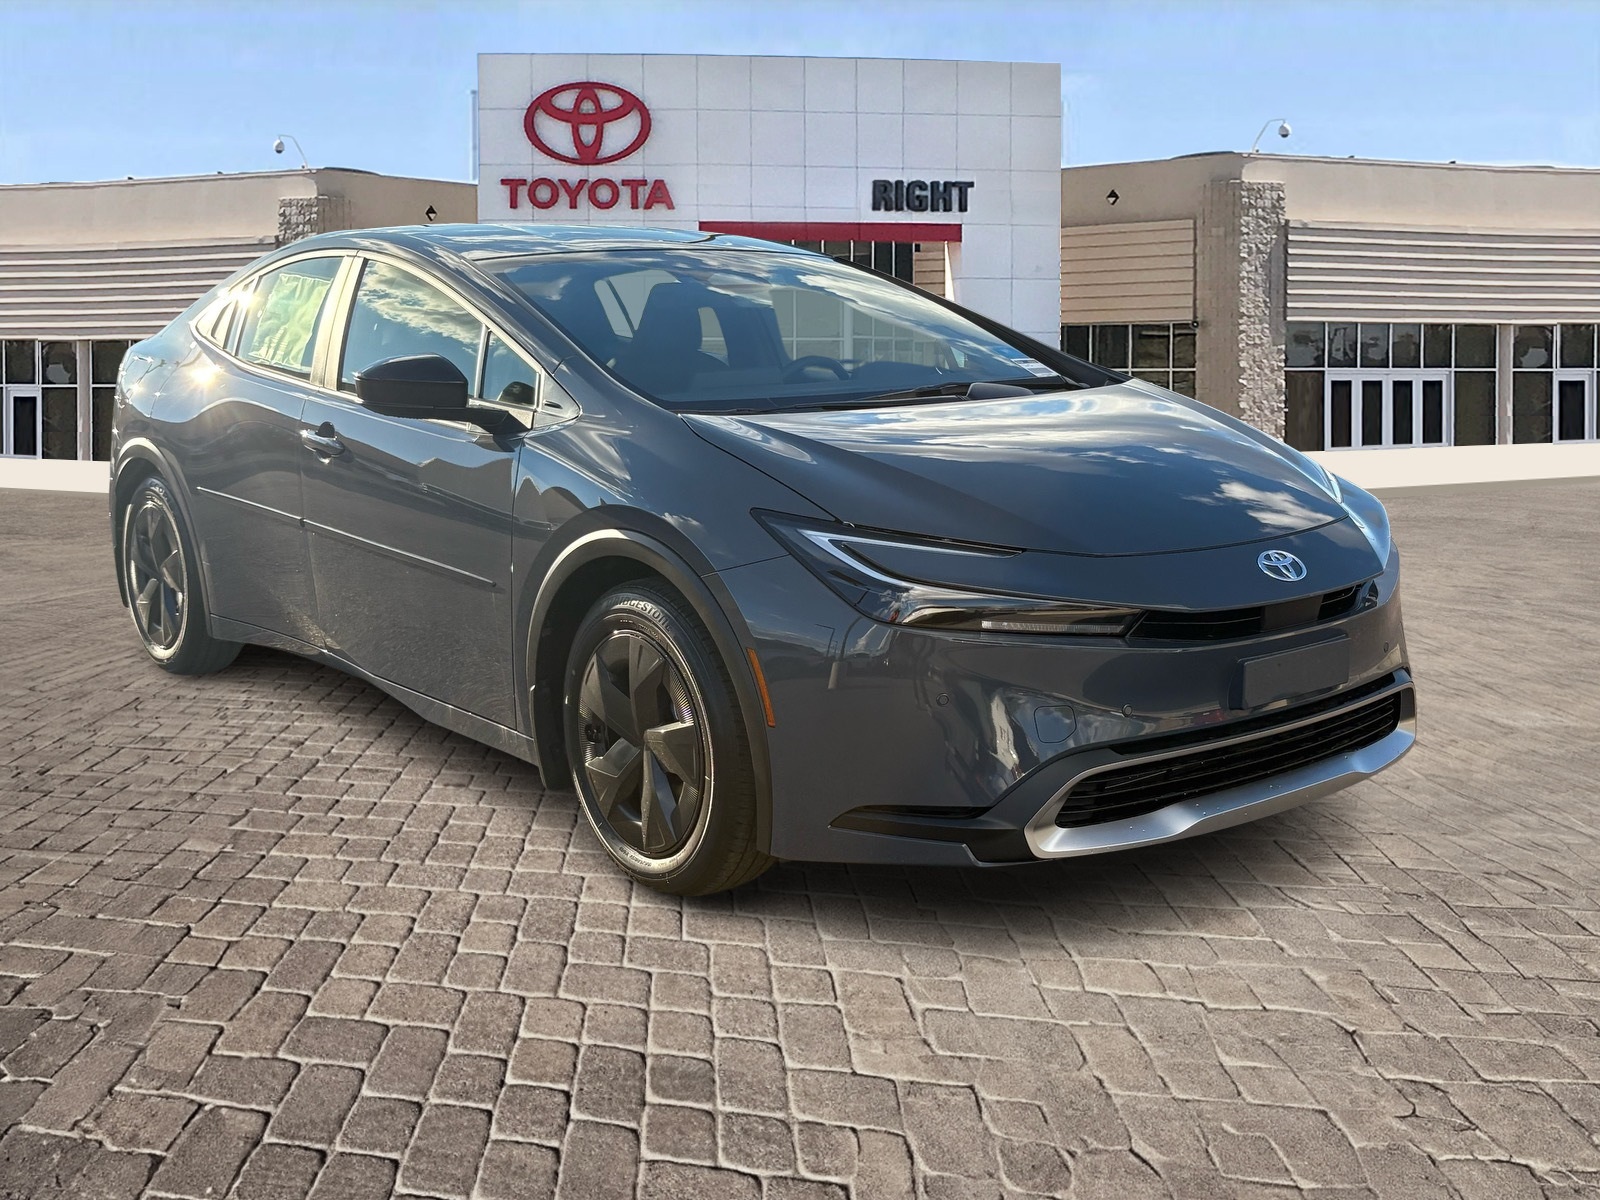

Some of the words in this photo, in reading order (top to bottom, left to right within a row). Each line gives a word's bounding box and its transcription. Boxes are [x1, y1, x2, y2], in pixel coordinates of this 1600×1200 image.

[500, 178, 675, 210] TOYOTA
[872, 180, 975, 212] RIGHT
[607, 596, 672, 632] IDGESTONE
